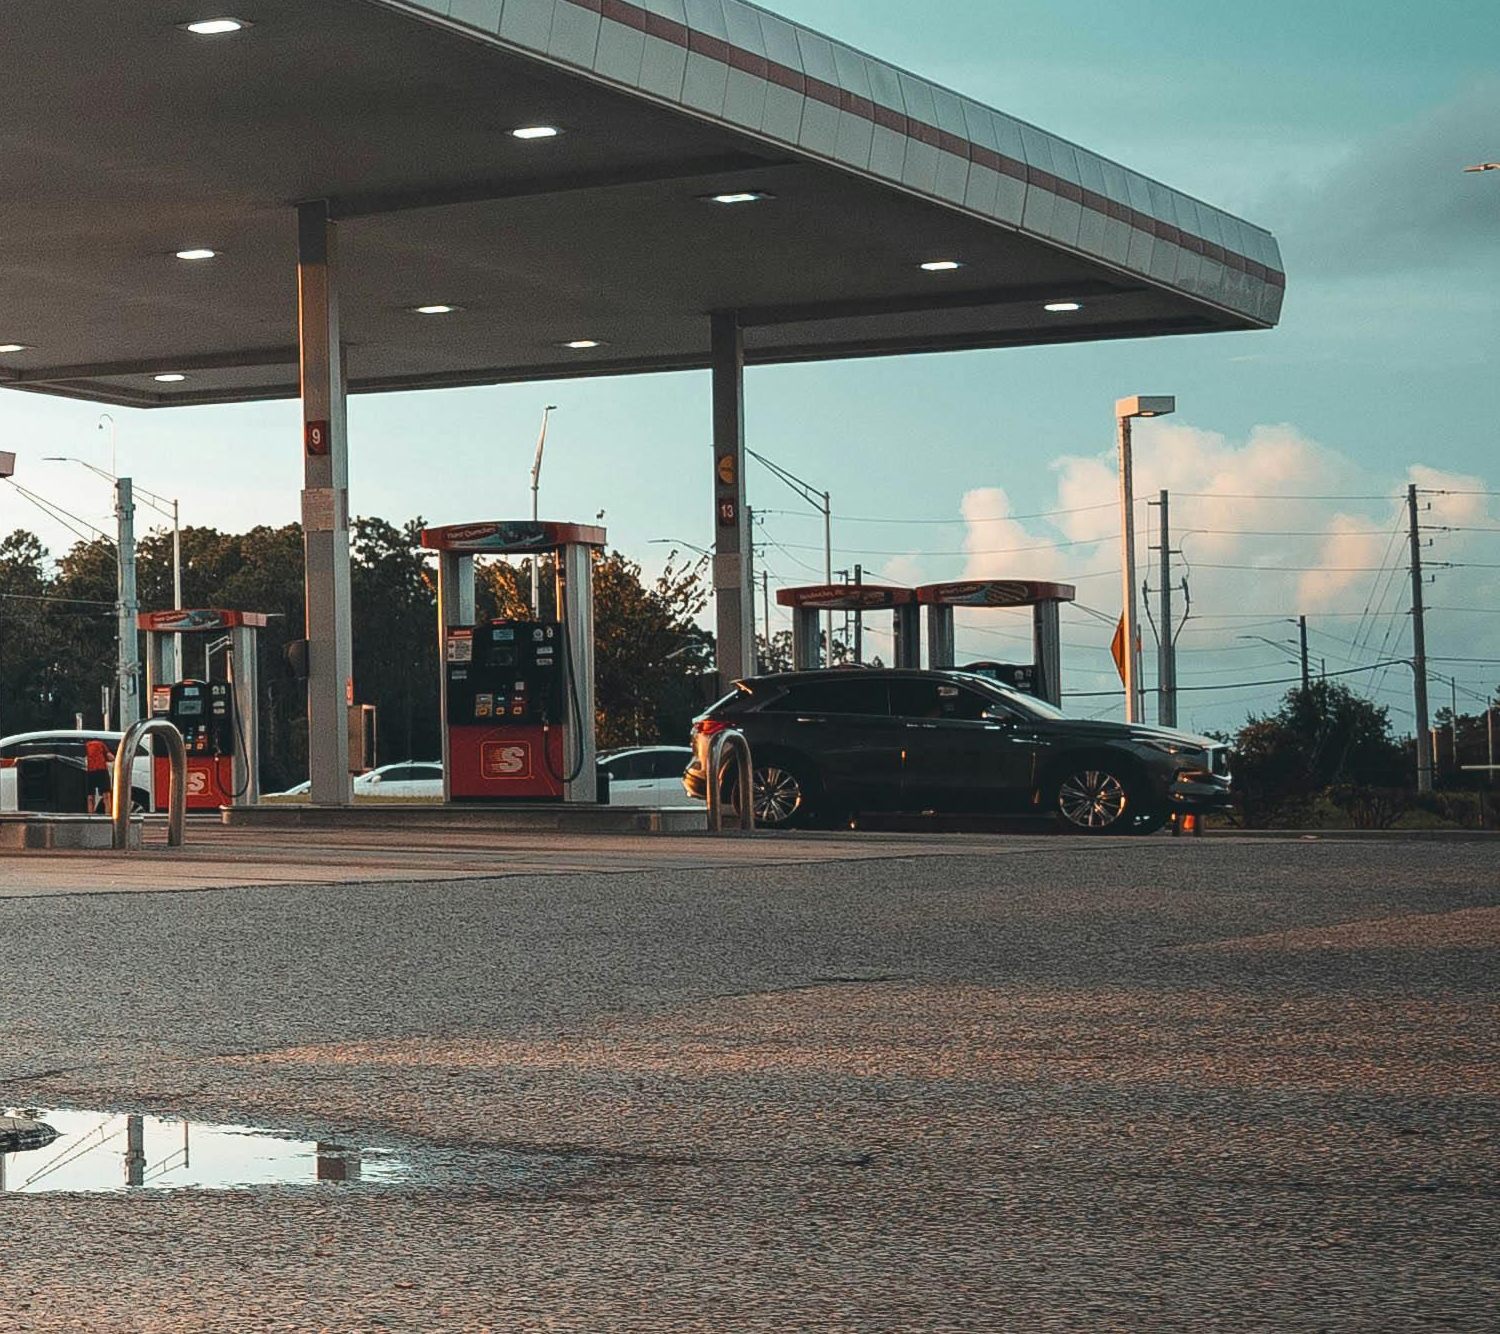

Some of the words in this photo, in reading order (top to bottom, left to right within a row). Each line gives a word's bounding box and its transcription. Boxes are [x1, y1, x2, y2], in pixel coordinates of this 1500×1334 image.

[311, 428, 321, 445] 9
[721, 504, 734, 518] 13
[546, 627, 554, 638] 9
[492, 747, 525, 772] S
